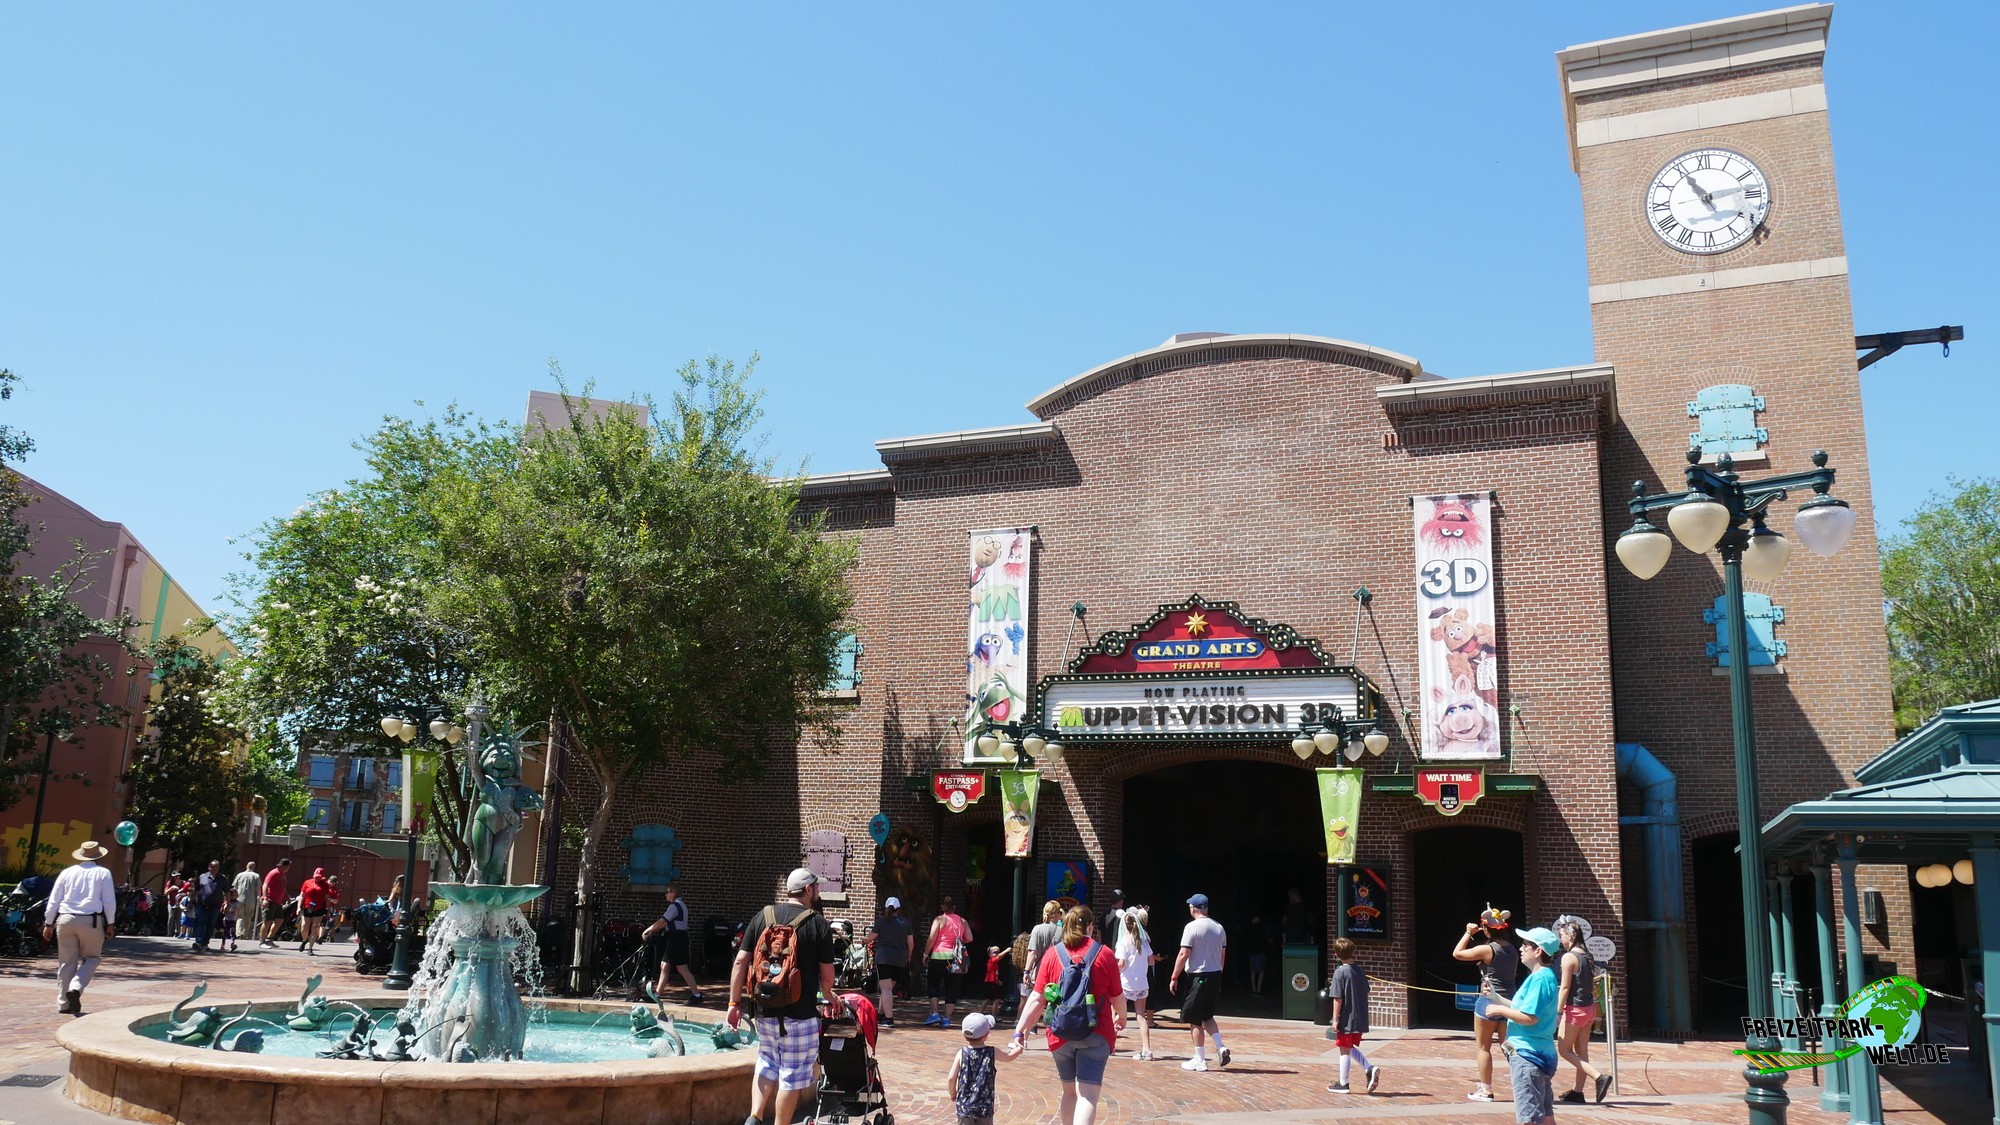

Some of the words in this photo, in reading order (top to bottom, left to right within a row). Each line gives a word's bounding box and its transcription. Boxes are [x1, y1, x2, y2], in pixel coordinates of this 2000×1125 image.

[1420, 557, 1489, 599] 3D
[1137, 645, 1200, 657] GRAND
[1207, 642, 1257, 655] ARTS
[1173, 661, 1221, 670] THEATRE
[1144, 687, 1175, 698] NOW
[1182, 686, 1245, 698] PLAYING
[1300, 702, 1339, 724] 3D
[939, 777, 979, 785] FASTPASS+
[1426, 773, 1449, 782] WAIT
[1450, 773, 1473, 782] TIME
[16, 837, 60, 857] RMP
